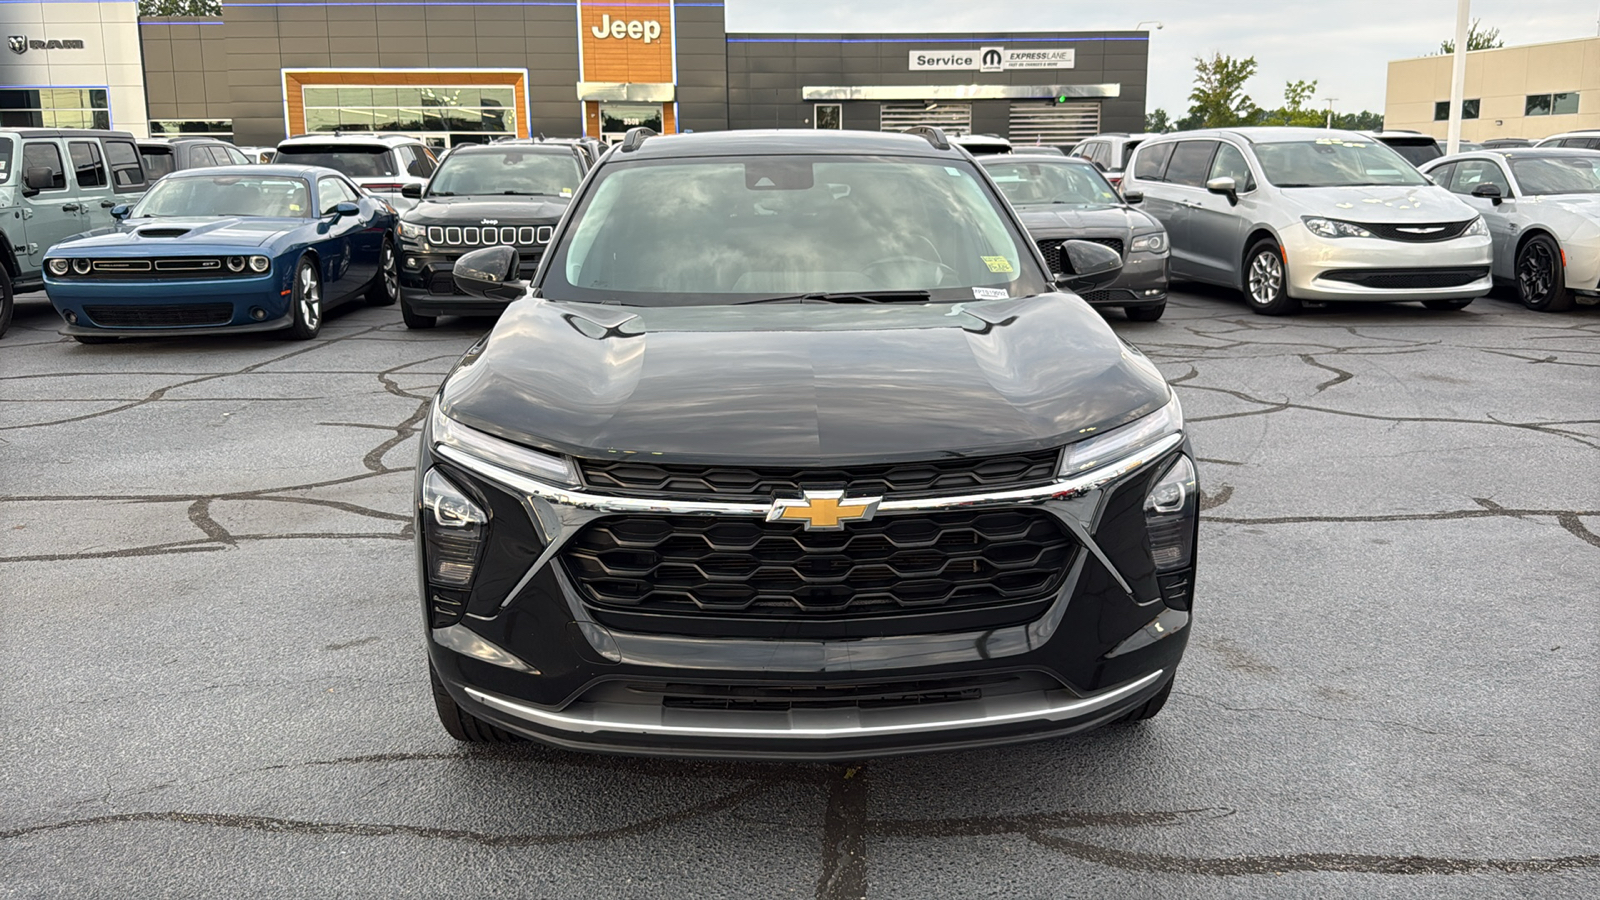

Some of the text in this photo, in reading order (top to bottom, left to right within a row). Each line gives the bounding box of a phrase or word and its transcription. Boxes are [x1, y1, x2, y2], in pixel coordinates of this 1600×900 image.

[591, 14, 661, 43] Jeep
[29, 39, 84, 50] RAM
[917, 55, 973, 66] Service
